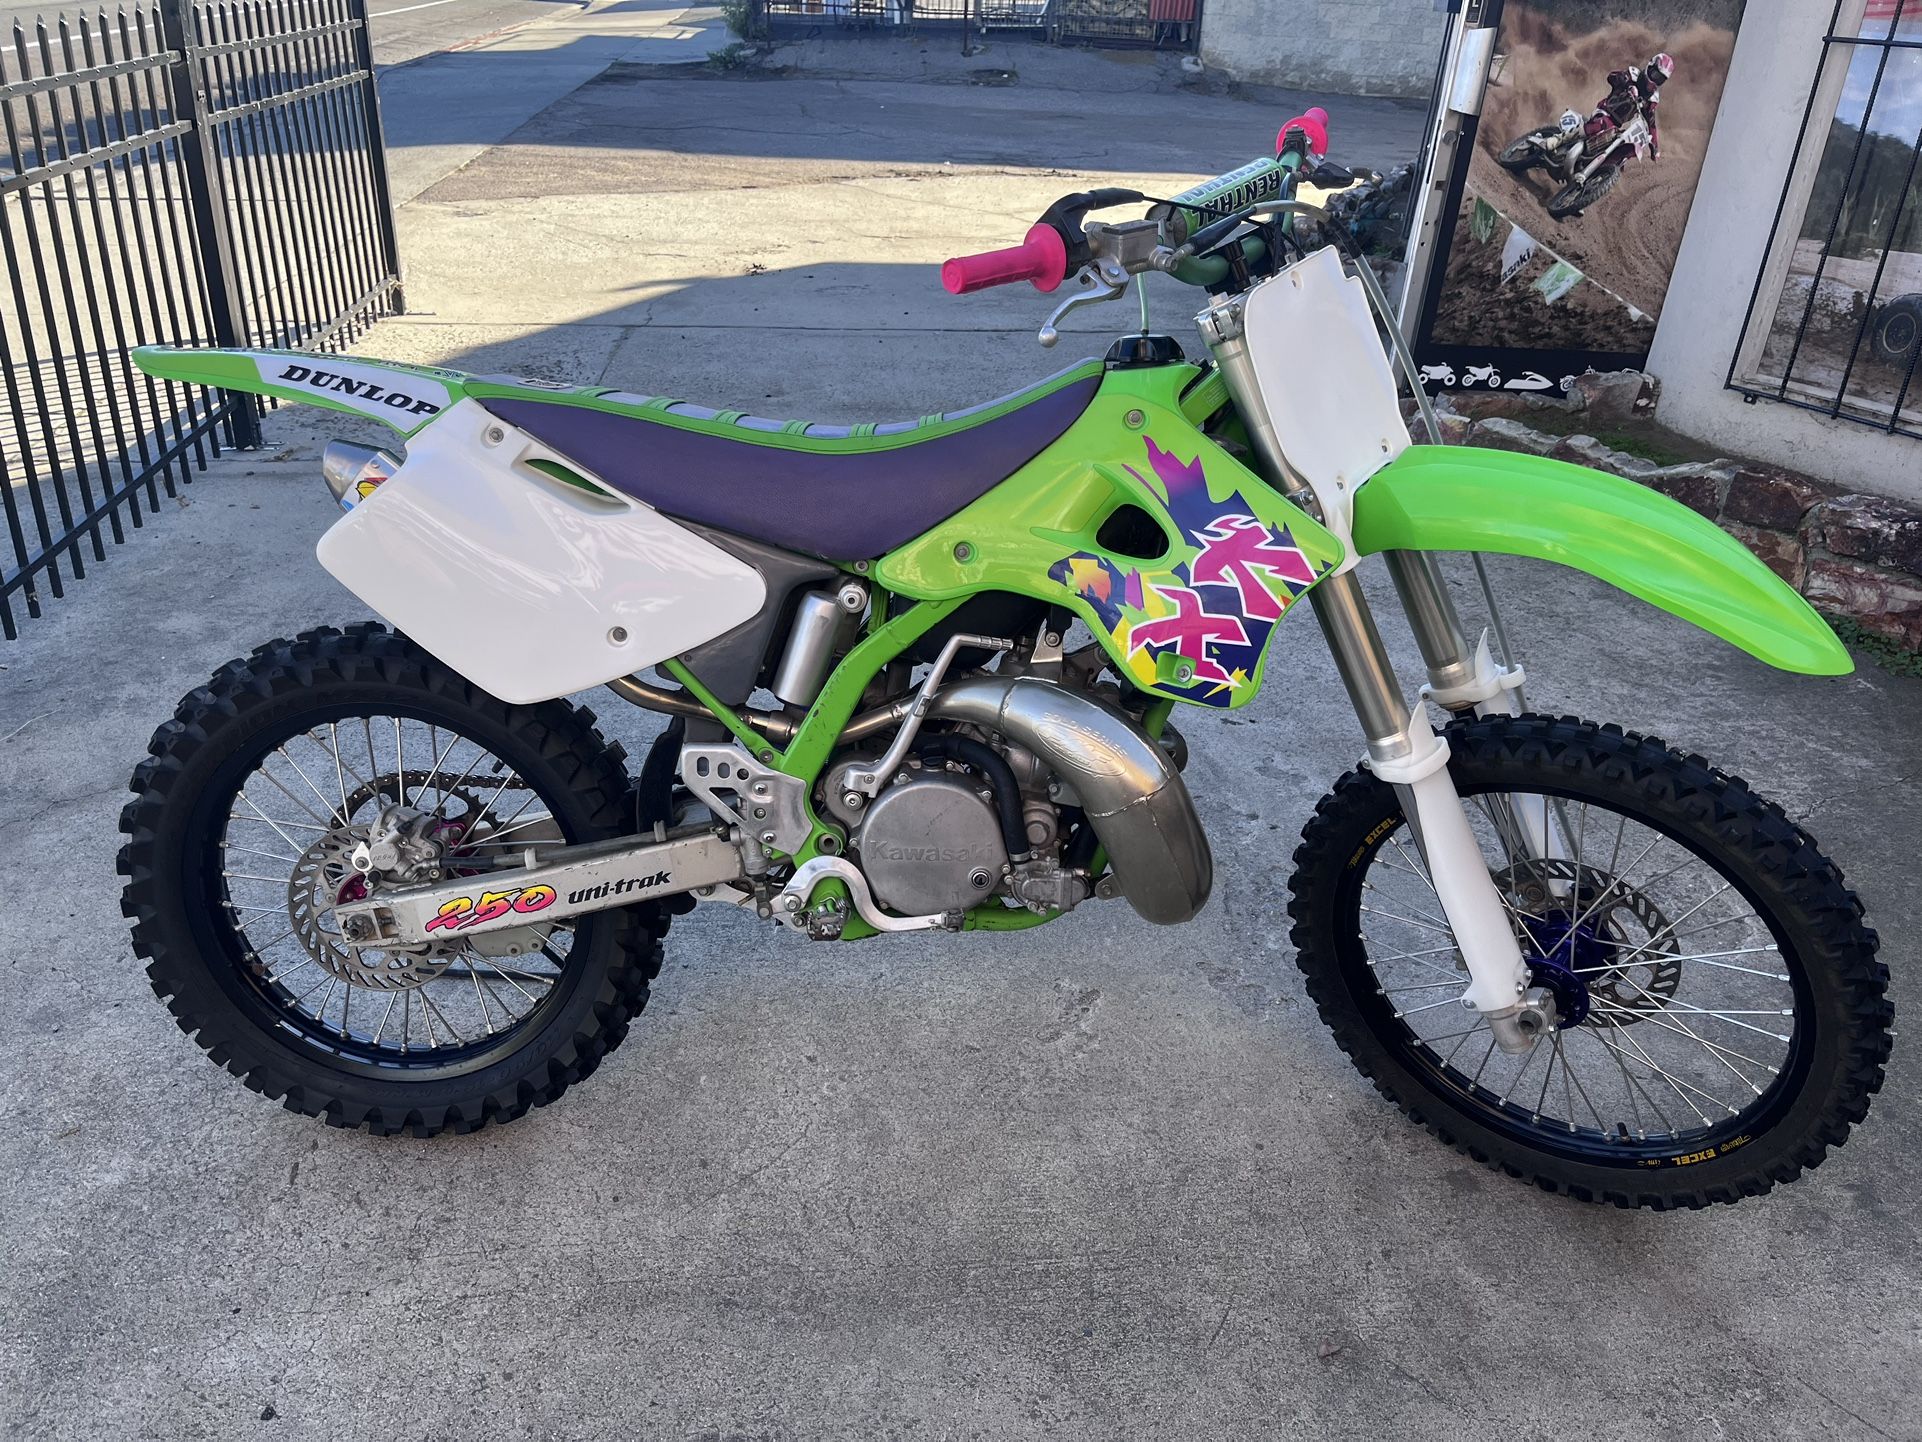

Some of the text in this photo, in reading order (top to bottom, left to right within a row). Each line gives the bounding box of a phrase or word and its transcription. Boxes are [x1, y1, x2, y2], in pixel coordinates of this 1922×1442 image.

[1630, 123, 1647, 147] 15
[1191, 168, 1281, 228] RENTHAL
[278, 364, 441, 416] DUNLOP
[1364, 818, 1396, 846] EXCEL
[869, 840, 994, 862] Kawasaki
[425, 870, 673, 932] 250 uni-trak
[1671, 1149, 1717, 1165] EXCEL
